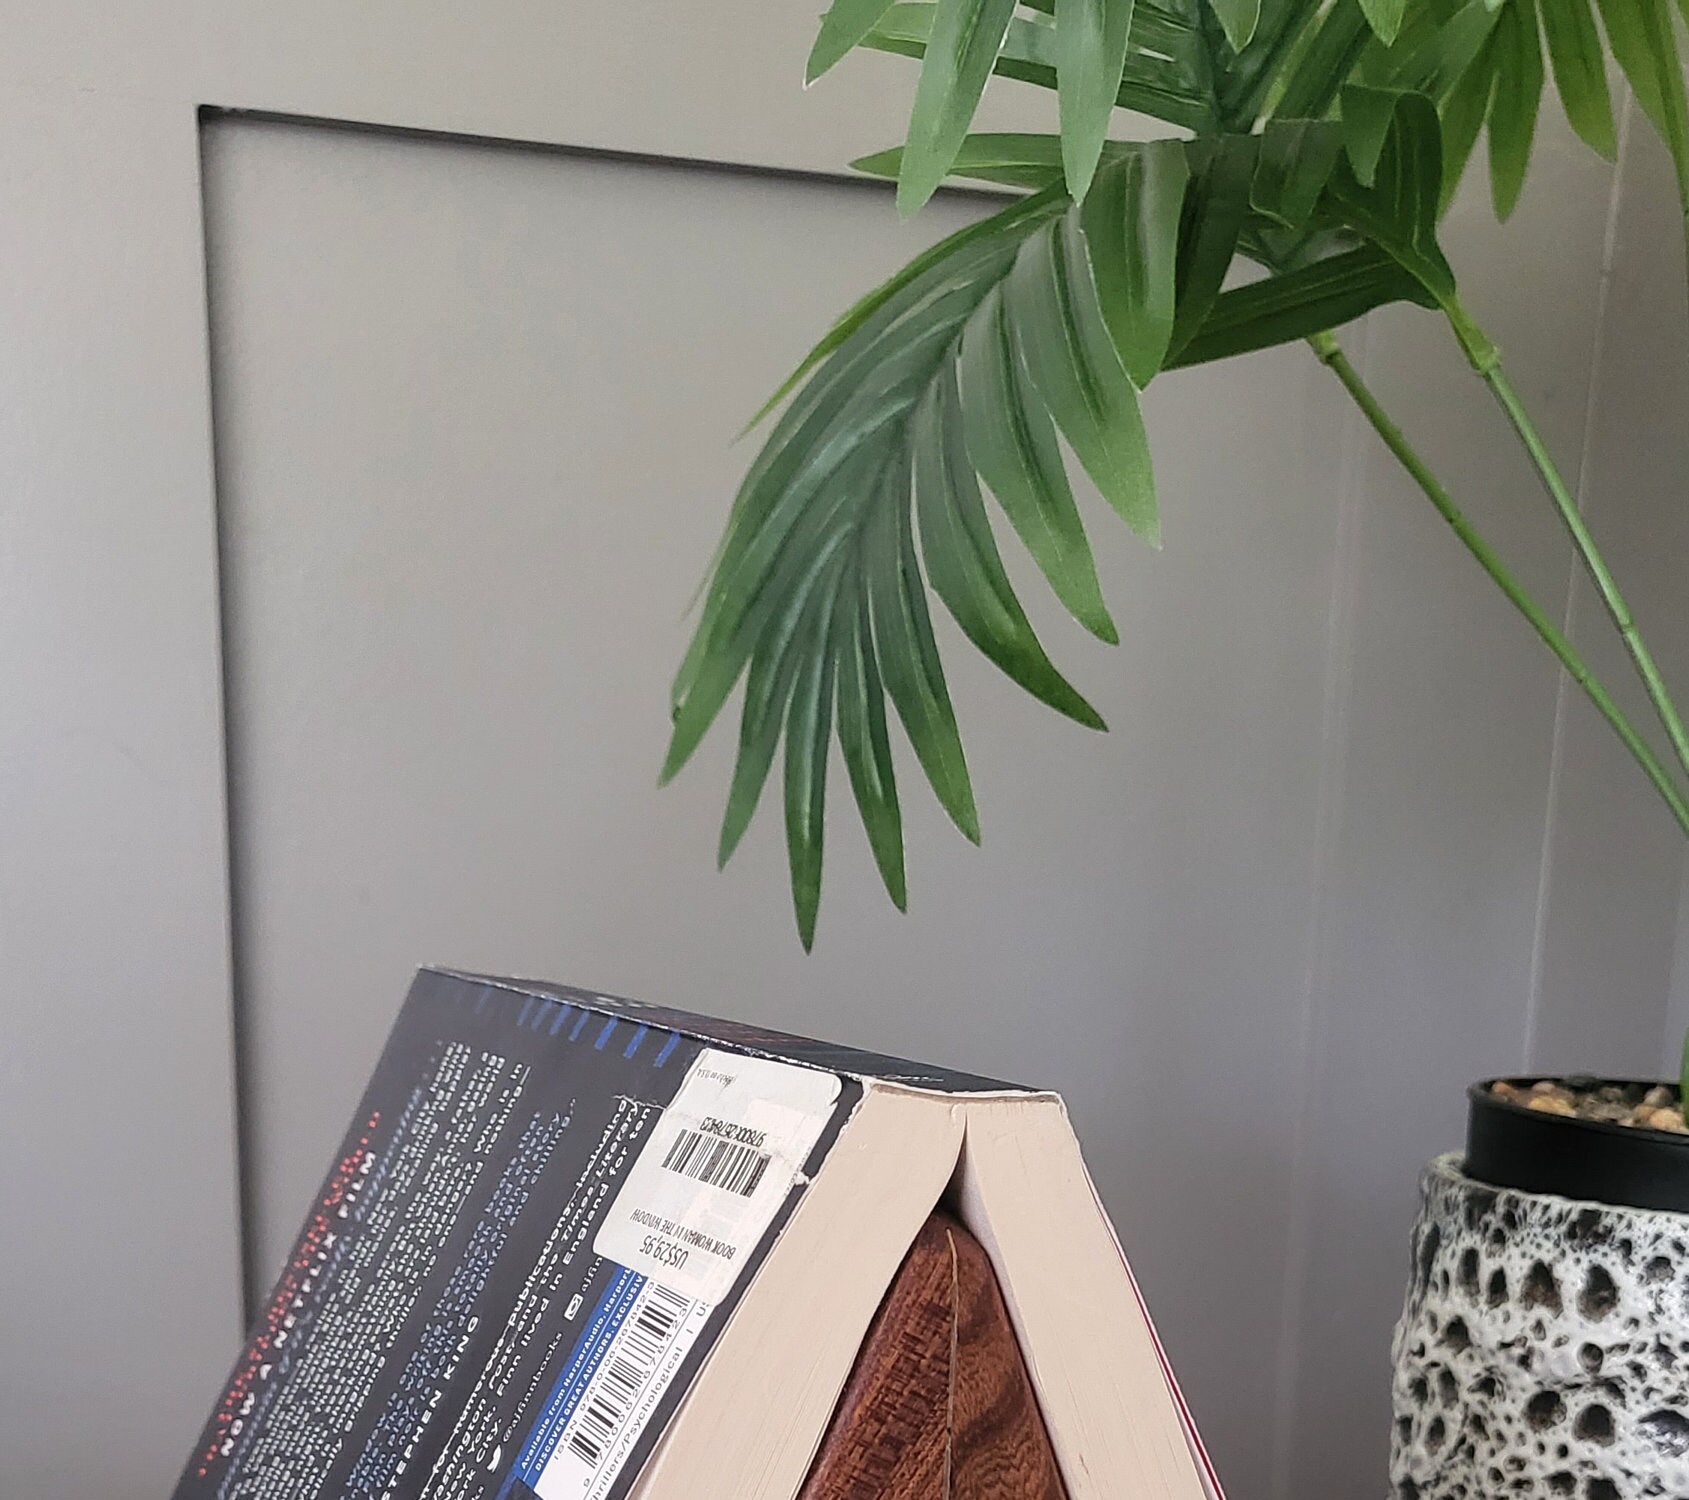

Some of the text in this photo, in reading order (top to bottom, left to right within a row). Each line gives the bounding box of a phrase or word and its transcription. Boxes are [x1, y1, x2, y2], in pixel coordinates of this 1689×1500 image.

[517, 1294, 537, 1331] and
[539, 1253, 558, 1284] the
[560, 1186, 593, 1241] Times
[595, 1101, 638, 1177] Literary
[630, 1208, 662, 1230] WINDOW
[638, 1235, 689, 1270] US$29,95
[661, 1218, 676, 1237] THE
[683, 1227, 713, 1250] WOMAN
[712, 1239, 736, 1260] BOOK
[220, 1152, 375, 1456] NOW A NETFLIX FILM
[466, 1406, 495, 1453] York,
[496, 1354, 520, 1396] Finn
[520, 1297, 549, 1346] lived
[549, 1273, 562, 1290] in
[562, 1183, 608, 1264] England
[608, 1146, 627, 1175] for
[629, 1107, 650, 1139] ten
[443, 1316, 478, 1379] KING
[503, 1333, 561, 1441] @ajfinnbooks
[553, 1281, 654, 1460] ISBN 978-0-06-267842-3
[521, 1418, 549, 1469] Available
[548, 1388, 565, 1415] from
[563, 1315, 606, 1386] HarperAudio,
[535, 1417, 565, 1470] DISCOVER
[563, 1381, 584, 1415] GREAT
[582, 1330, 614, 1380] AUTHORS,
[475, 1418, 501, 1462] City.
